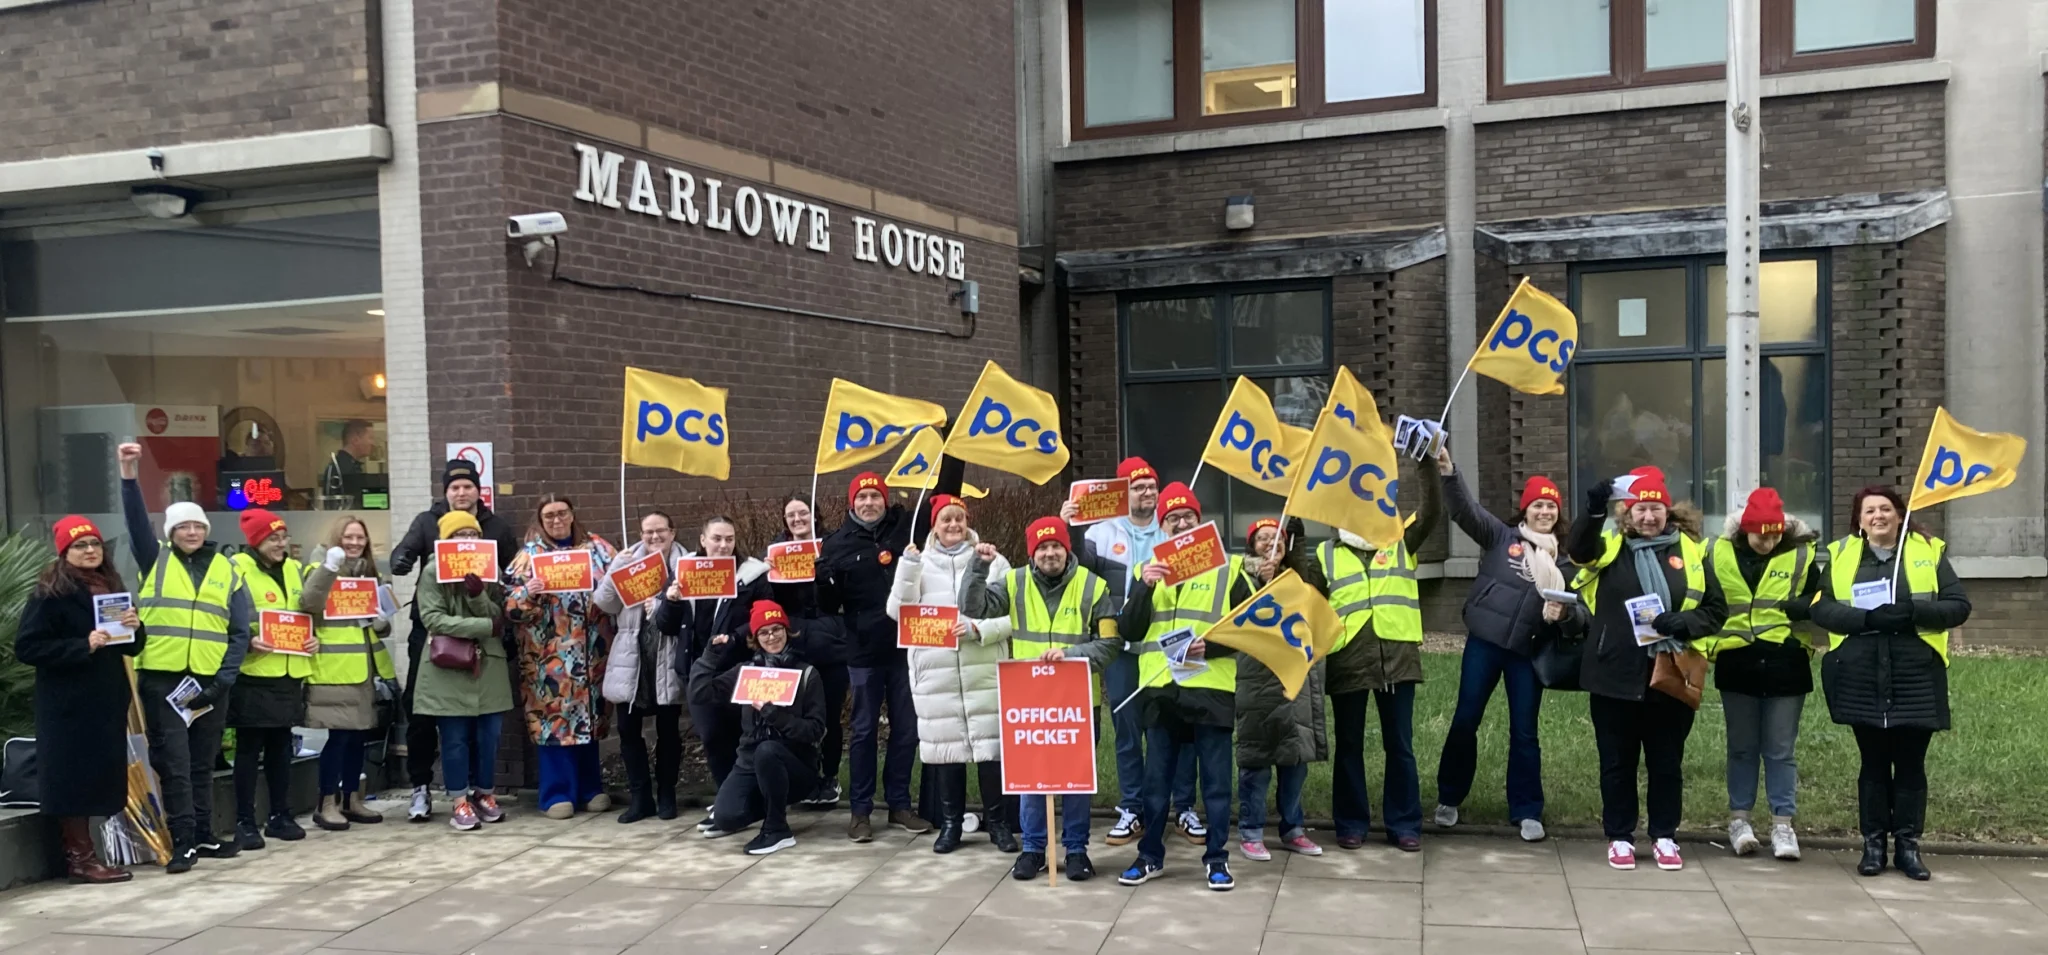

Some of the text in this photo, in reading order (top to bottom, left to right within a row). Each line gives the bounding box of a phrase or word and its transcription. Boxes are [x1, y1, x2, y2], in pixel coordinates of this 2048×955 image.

[573, 142, 965, 280] MARLOWE HOUSE
[1489, 308, 1574, 373] pcs
[636, 400, 725, 446] pcs
[968, 396, 1057, 455] pcs
[1219, 410, 1290, 480] pcs
[1130, 467, 1150, 479] pcs
[860, 478, 878, 488] pcs
[1306, 445, 1399, 517] pcs
[1088, 483, 1107, 493] pcs
[1079, 491, 1125, 503] SUPPORT
[1639, 490, 1662, 501] pcs
[1079, 499, 1119, 511] THE PCS
[1165, 496, 1186, 508] pcs
[1082, 507, 1116, 519] STRIKE
[69, 524, 92, 538] pcs
[1036, 526, 1056, 539] pcs
[1761, 522, 1782, 534] pcs
[457, 543, 476, 552] pcs
[1174, 535, 1195, 550] pcs
[786, 545, 802, 554] pcs
[1168, 537, 1215, 565] SUPPORT
[447, 553, 492, 561] SUPPORT
[553, 554, 570, 563] pcs
[1171, 550, 1213, 572] THE PCS
[448, 560, 487, 569] THE PCS
[544, 563, 587, 573] SUPPORT
[629, 562, 646, 576] pcs
[696, 561, 714, 569] pcs
[778, 562, 815, 572] THE PCS
[1914, 559, 1933, 568] pcs
[686, 570, 731, 580] SUPPORT
[780, 570, 812, 579] STRIKE
[1177, 560, 1212, 579] STRIKE
[1769, 569, 1790, 579] pcs
[545, 571, 583, 581] THE PCS
[624, 564, 662, 588] SUPPORT
[208, 578, 224, 590] pcs
[341, 581, 358, 590] pcs
[548, 579, 580, 588] STRIKE
[628, 575, 662, 595] THE PCS
[686, 578, 725, 588] THE PCS
[1190, 582, 1210, 591] pcs
[332, 590, 374, 599] SUPPORT
[633, 583, 662, 601] STRIKE
[689, 586, 723, 594] STRIKE
[1858, 588, 1871, 596] pcs
[334, 599, 370, 608] THE PCS
[336, 606, 367, 614] STRIKE
[920, 607, 938, 617] pcs
[279, 614, 295, 623] pcs
[909, 618, 953, 629] SUPPORT
[270, 623, 308, 634] SUPPORT
[910, 626, 947, 636] THE PCS
[272, 631, 304, 642] THE PCS
[911, 635, 944, 645] STRIKE
[274, 640, 303, 650] STRIKE
[1032, 664, 1055, 678] pcs
[1006, 707, 1086, 723] OFFICIAL
[1014, 729, 1080, 745] PICKET
